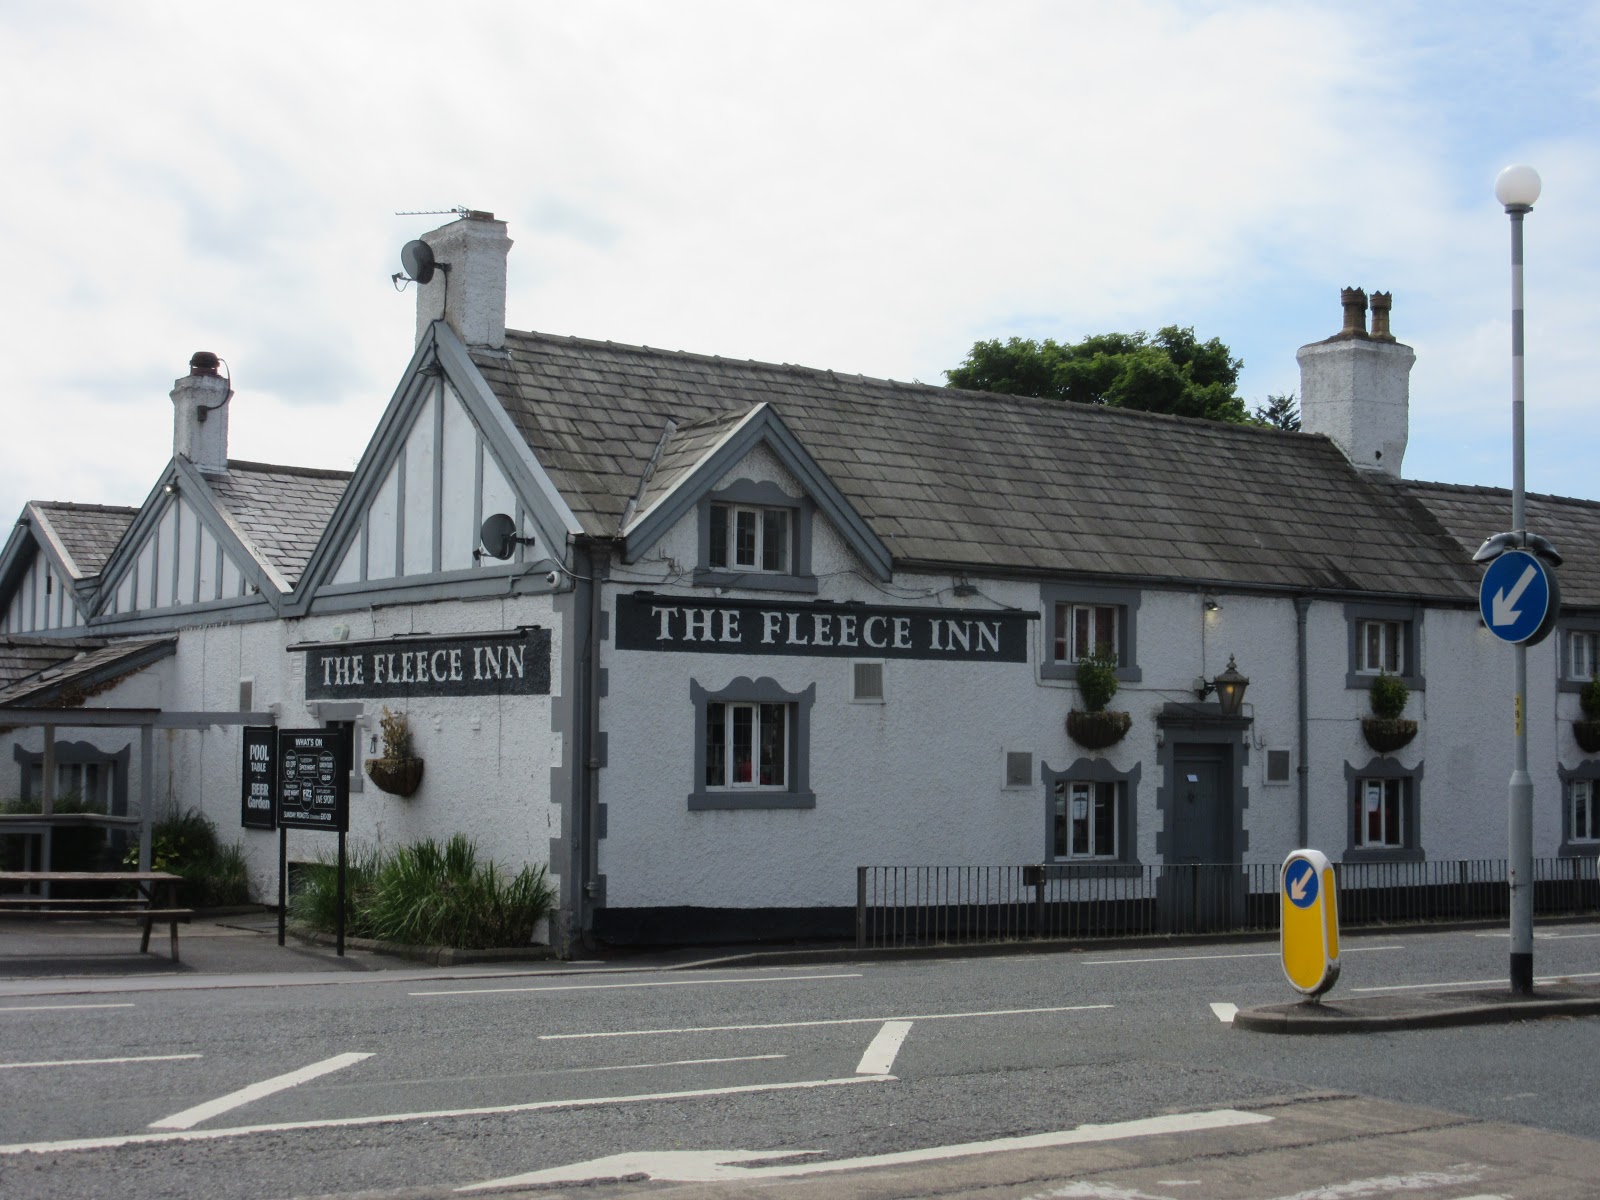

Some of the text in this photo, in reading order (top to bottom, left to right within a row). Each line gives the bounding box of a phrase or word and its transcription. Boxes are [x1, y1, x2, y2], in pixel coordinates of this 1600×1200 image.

[651, 606, 1002, 653] THE FLEECE INN
[321, 644, 527, 686] THE FLEECE INN
[295, 738, 323, 747] WHAT'S ON
[249, 744, 270, 761] POOL
[251, 762, 267, 773] TABLE
[251, 783, 269, 796] BEER
[247, 796, 270, 810] Garden
[315, 795, 323, 804] LIVE
[323, 795, 335, 804] SPORT
